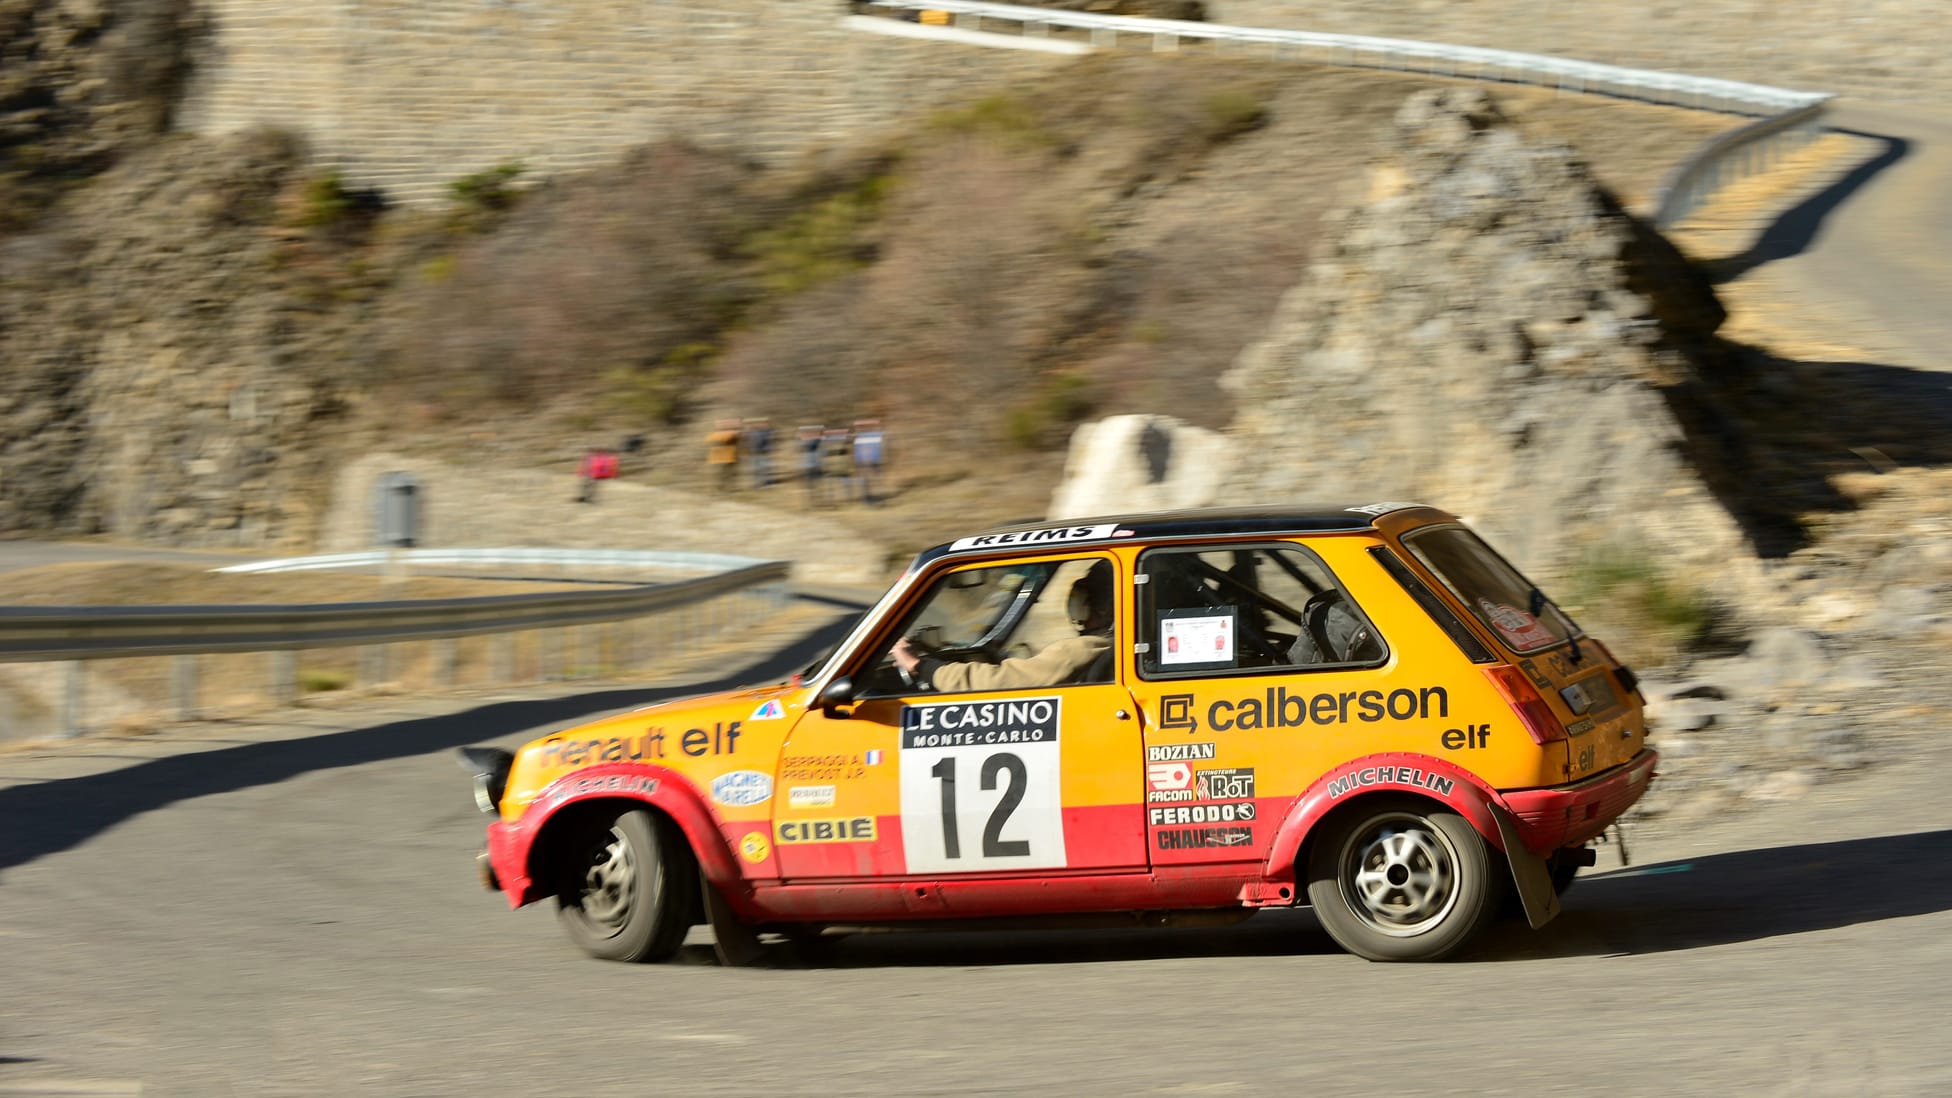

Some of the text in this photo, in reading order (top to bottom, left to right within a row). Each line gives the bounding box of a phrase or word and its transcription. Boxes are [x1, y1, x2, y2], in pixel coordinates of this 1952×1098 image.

[972, 526, 1095, 546] REIMS
[906, 701, 1053, 731] LE CASINO
[1207, 686, 1449, 732] calberson
[681, 721, 742, 757] elf
[1441, 724, 1491, 750] elf
[1149, 743, 1214, 761] BOZIAN
[1328, 765, 1454, 799] MICHELIN
[931, 752, 1031, 860] 12
[1149, 790, 1192, 802] FACOM
[1151, 805, 1235, 825] FERODO
[1157, 827, 1254, 850] CHAUSSON
